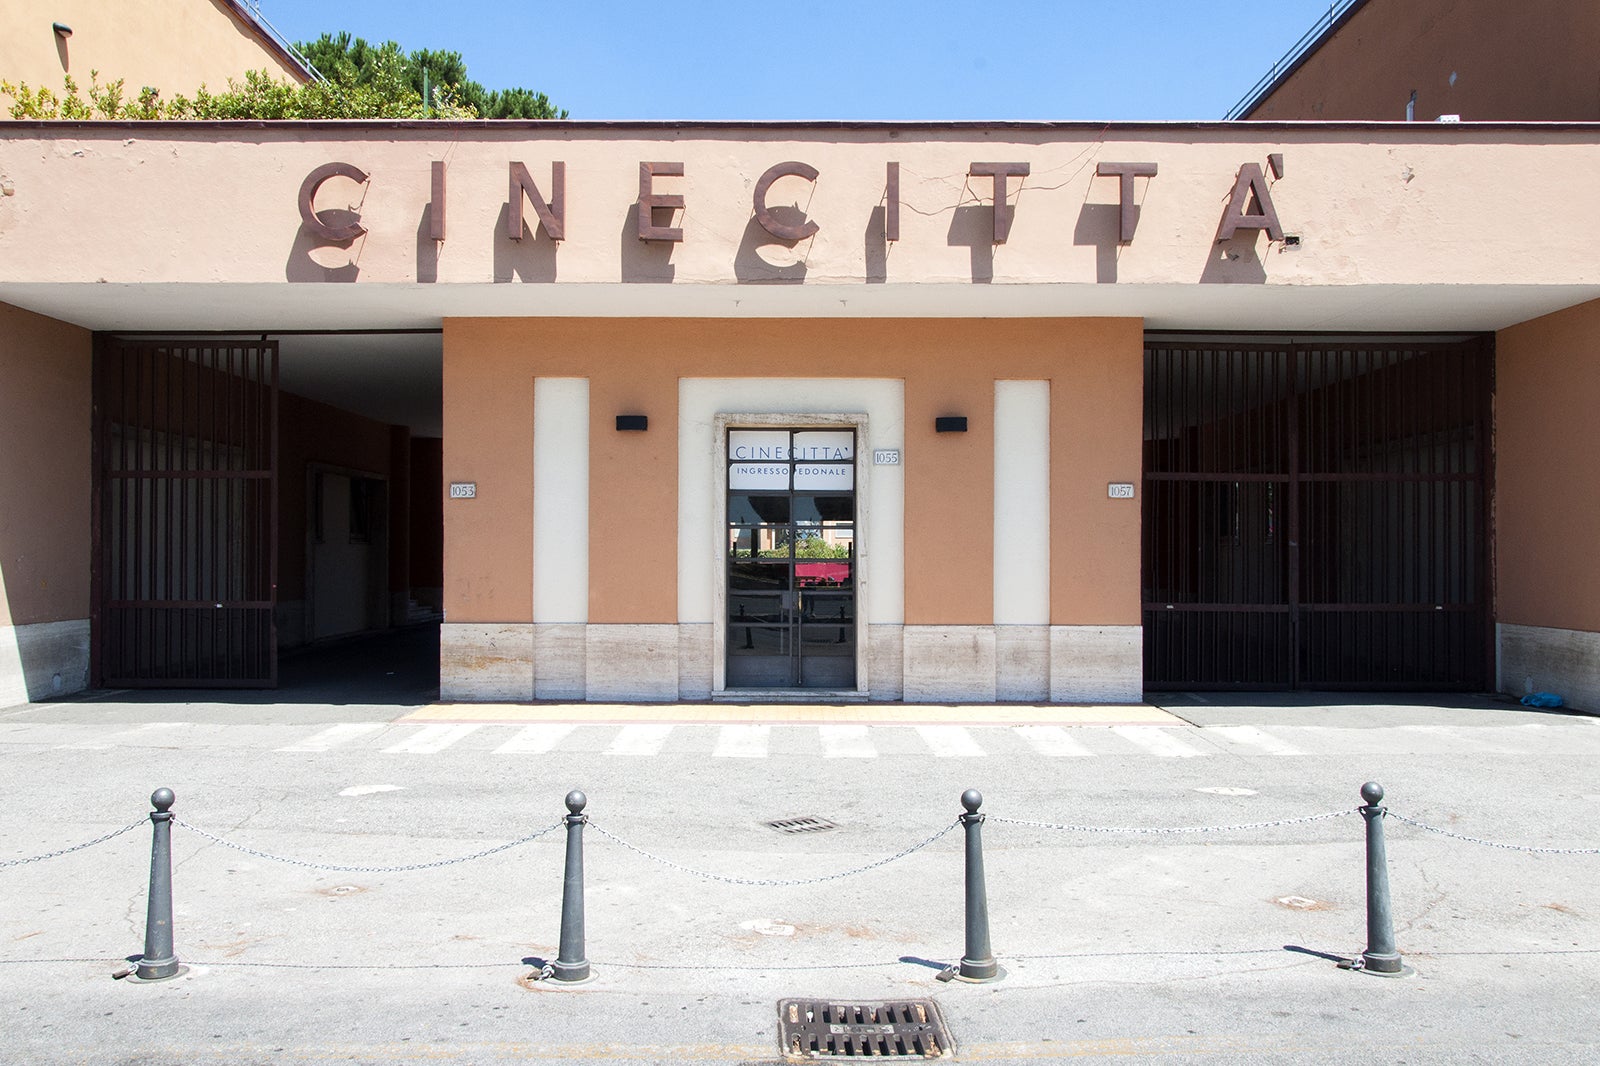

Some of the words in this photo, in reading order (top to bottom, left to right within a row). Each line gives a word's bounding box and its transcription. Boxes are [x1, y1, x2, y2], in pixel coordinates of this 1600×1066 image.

[876, 453, 898, 463] 1055
[737, 467, 789, 475] INGRESSO
[452, 486, 474, 496] 1053
[1111, 486, 1132, 496] 1057
